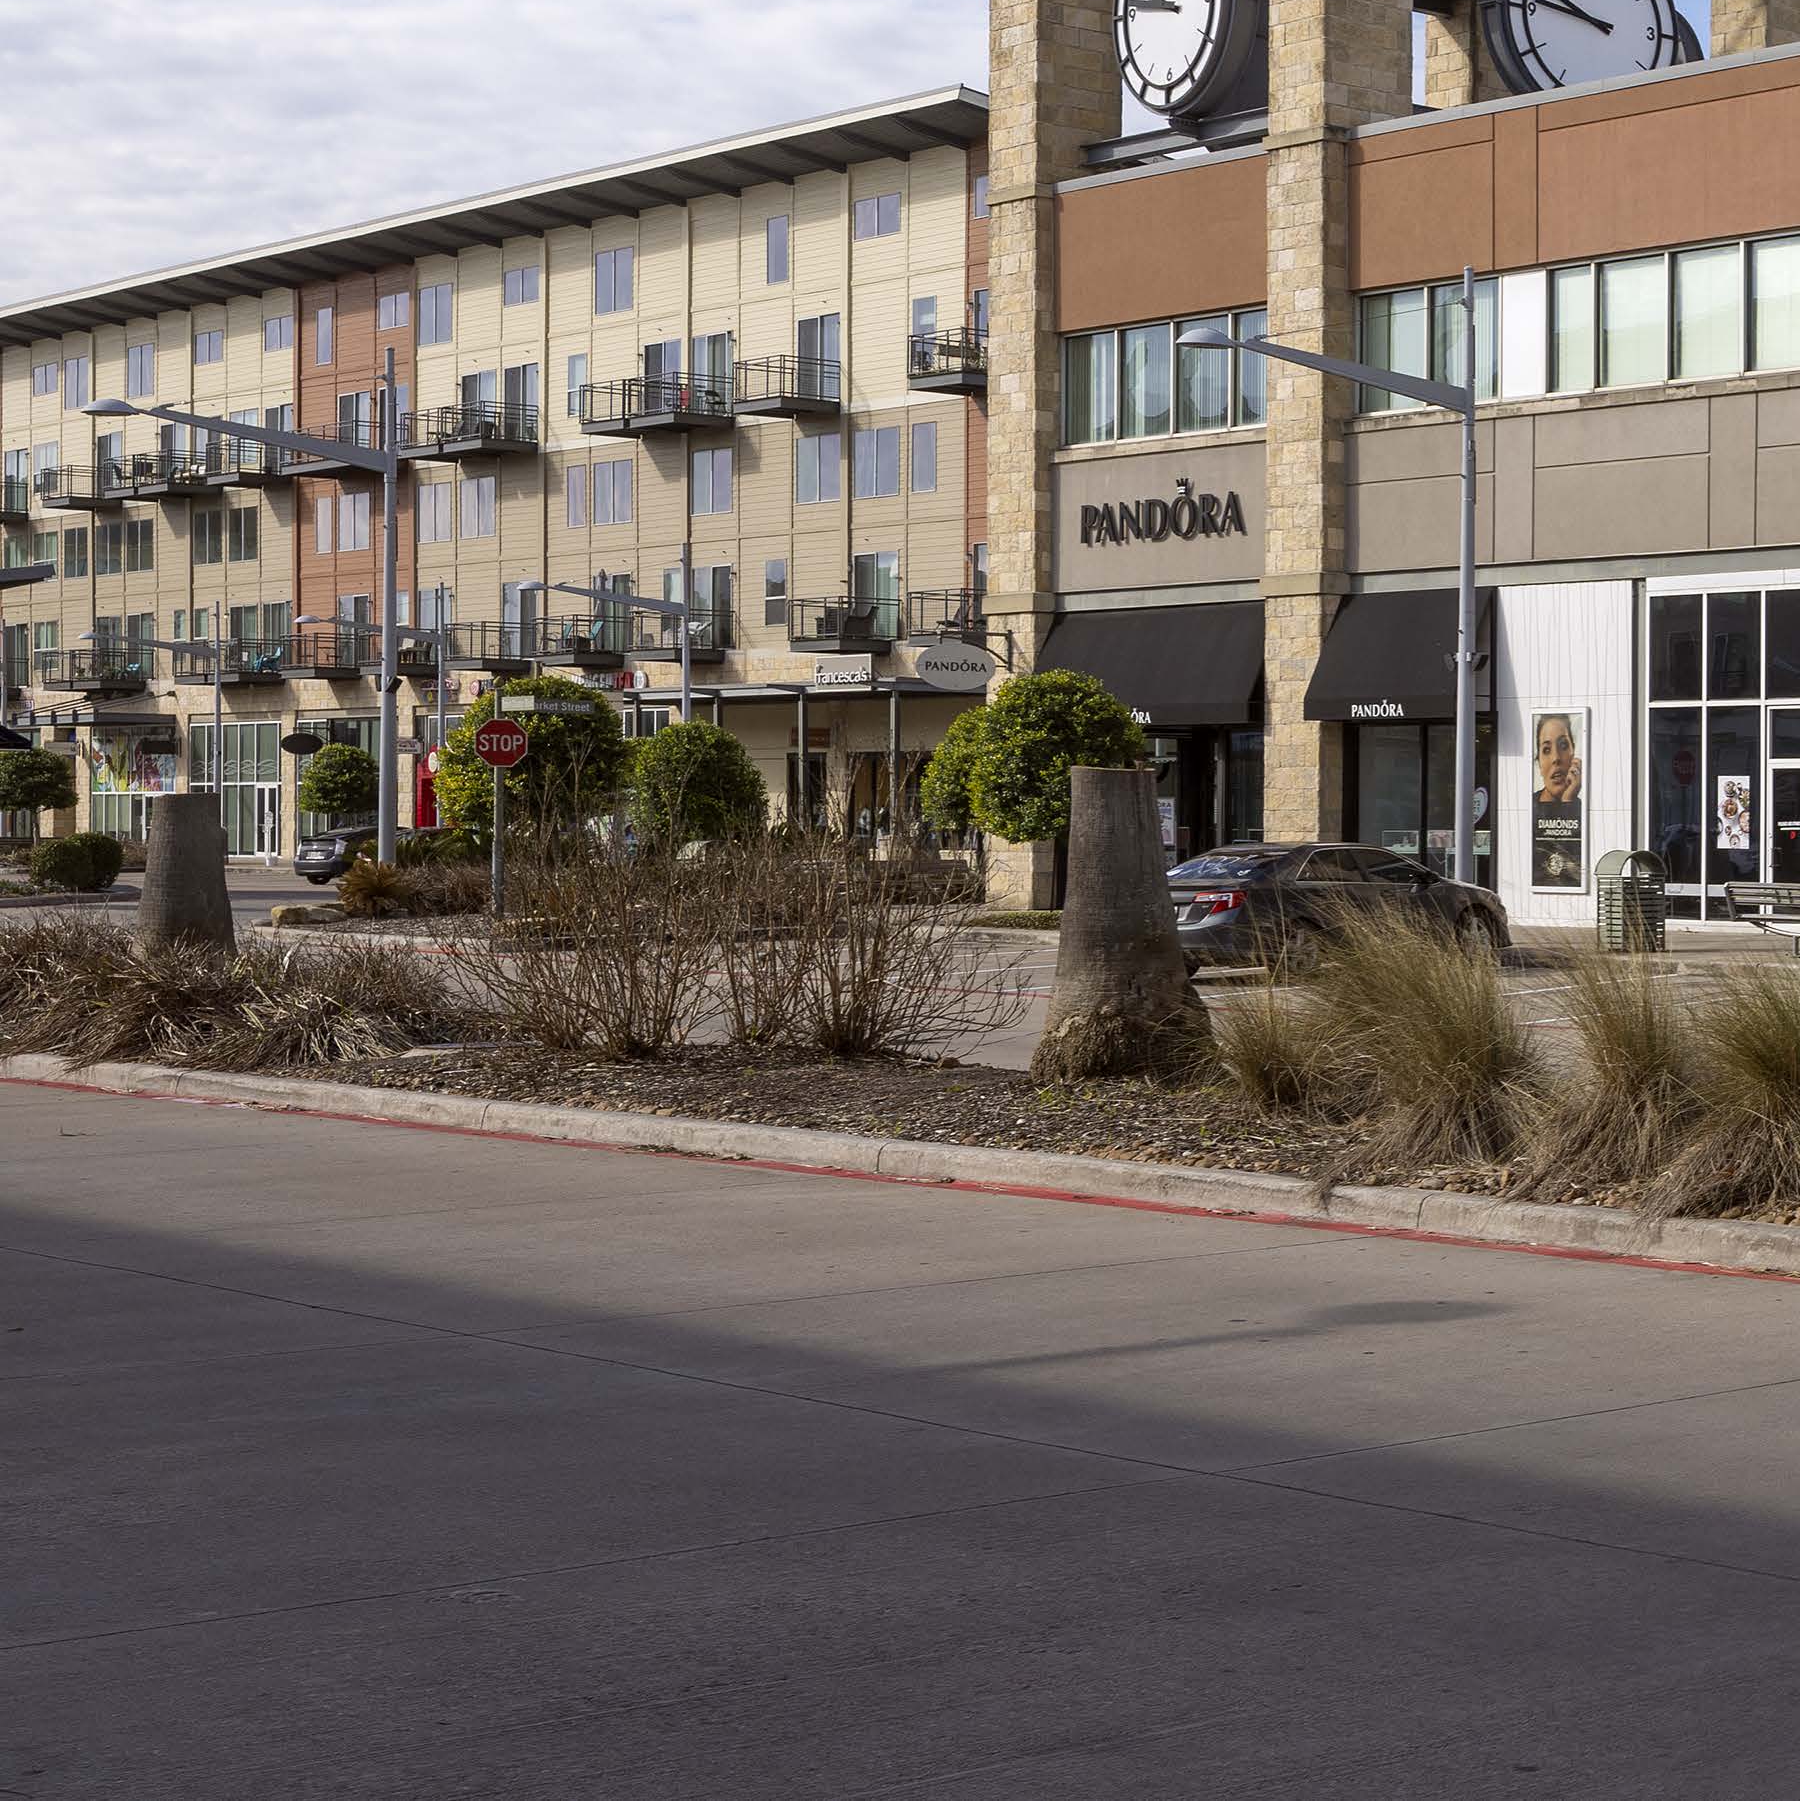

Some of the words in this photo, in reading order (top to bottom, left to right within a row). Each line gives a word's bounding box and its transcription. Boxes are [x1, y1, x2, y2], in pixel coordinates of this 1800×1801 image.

[1128, 7, 1137, 23] 9
[1527, 1, 1537, 17] 9
[1646, 26, 1656, 41] 3
[1166, 67, 1173, 82] 6
[815, 665, 869, 686] francesca's
[560, 701, 590, 712] Street
[478, 734, 524, 752] STOP
[1538, 819, 1579, 829] DIAMONDS
